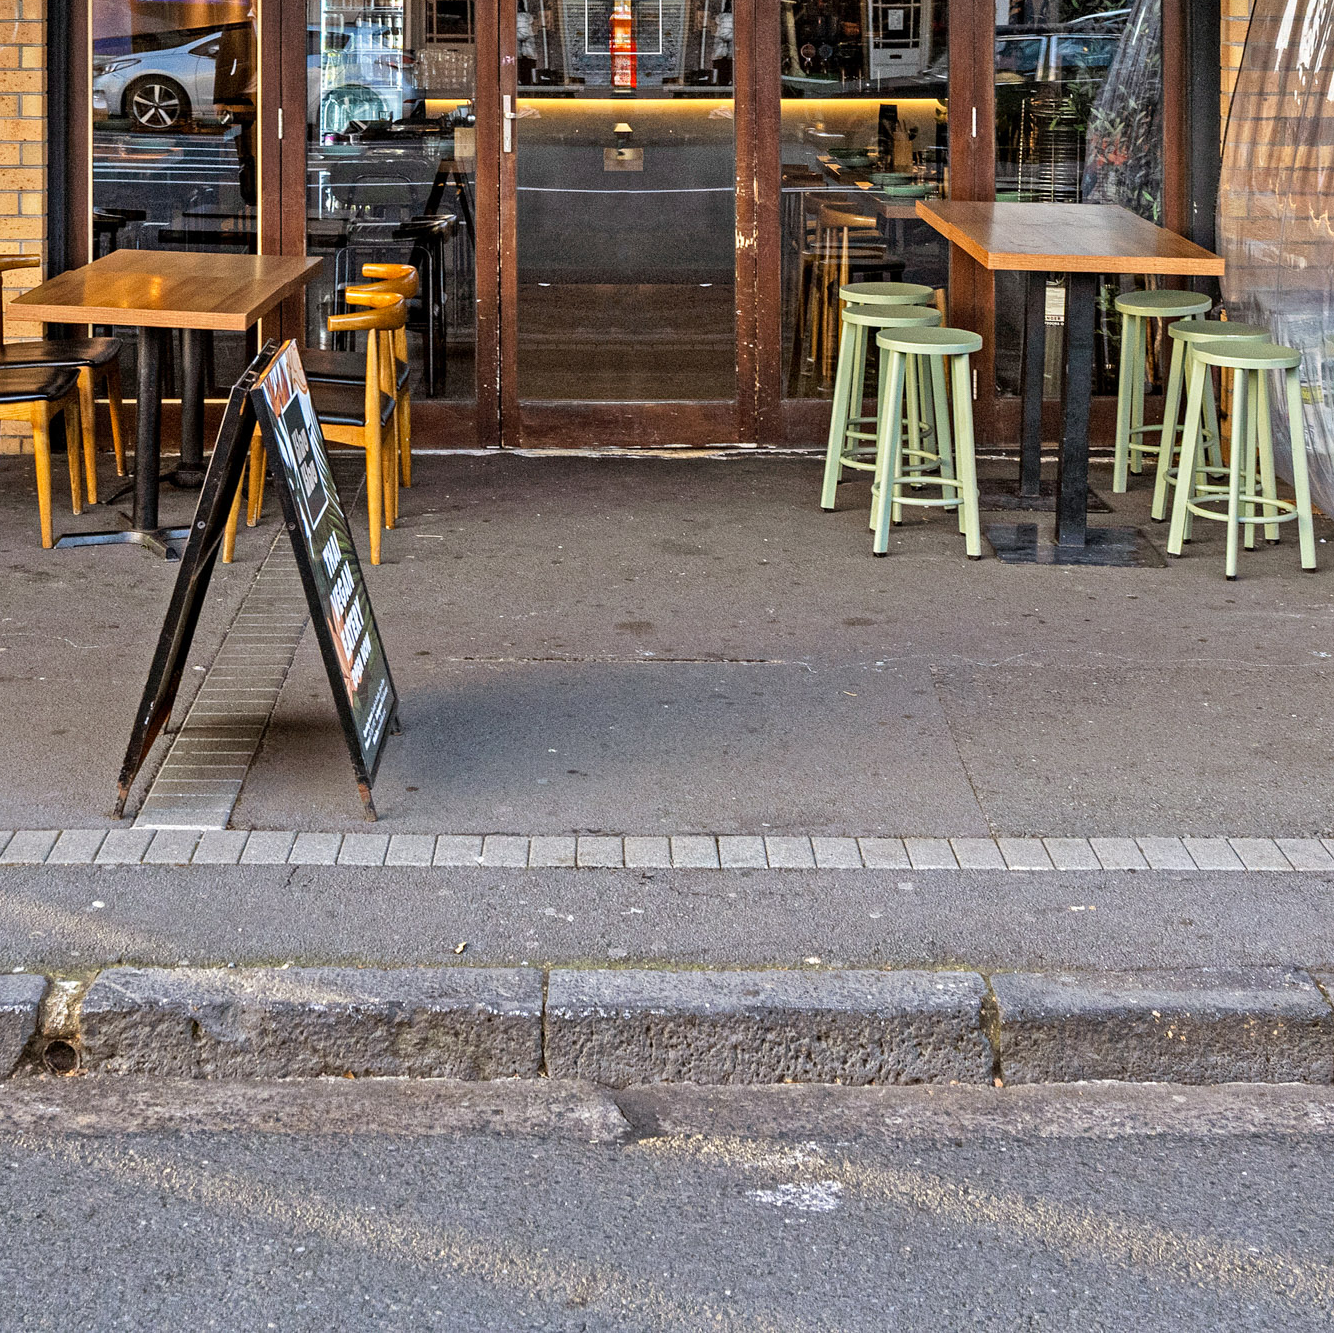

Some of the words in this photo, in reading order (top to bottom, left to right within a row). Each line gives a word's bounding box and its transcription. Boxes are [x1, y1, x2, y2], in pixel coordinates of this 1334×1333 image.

[322, 530, 342, 579] THAI
[330, 560, 355, 622] VEGAN
[340, 595, 365, 663] EATERY
